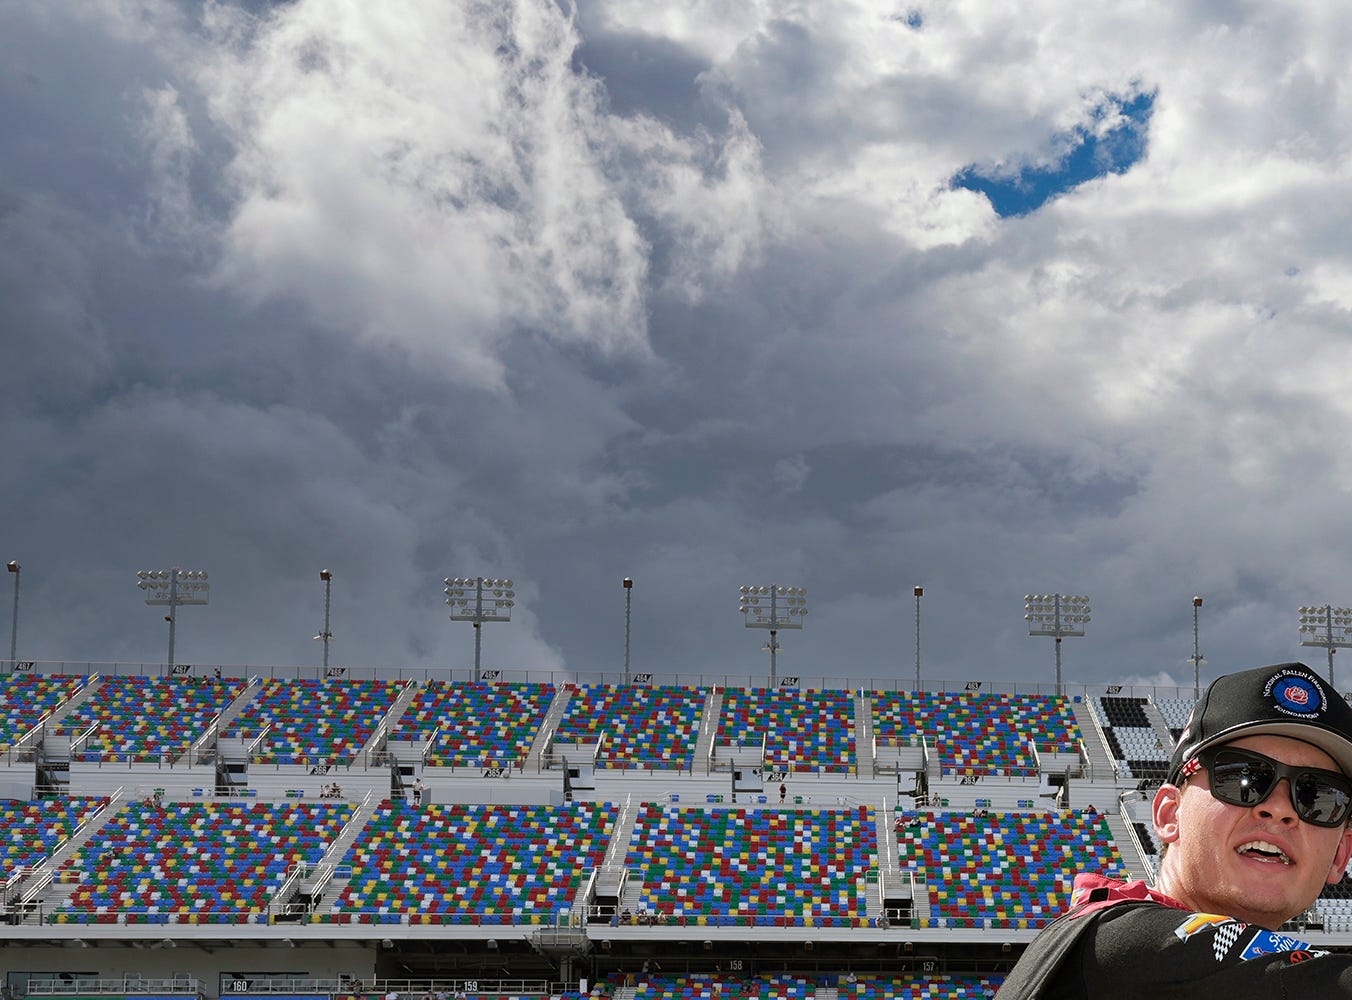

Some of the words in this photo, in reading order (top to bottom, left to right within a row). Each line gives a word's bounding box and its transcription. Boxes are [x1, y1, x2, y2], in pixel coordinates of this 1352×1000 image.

[1282, 670, 1308, 679] FALLEN
[729, 960, 743, 971] 158
[923, 961, 935, 971] 157
[232, 980, 247, 992] 160
[464, 981, 478, 992] 159
